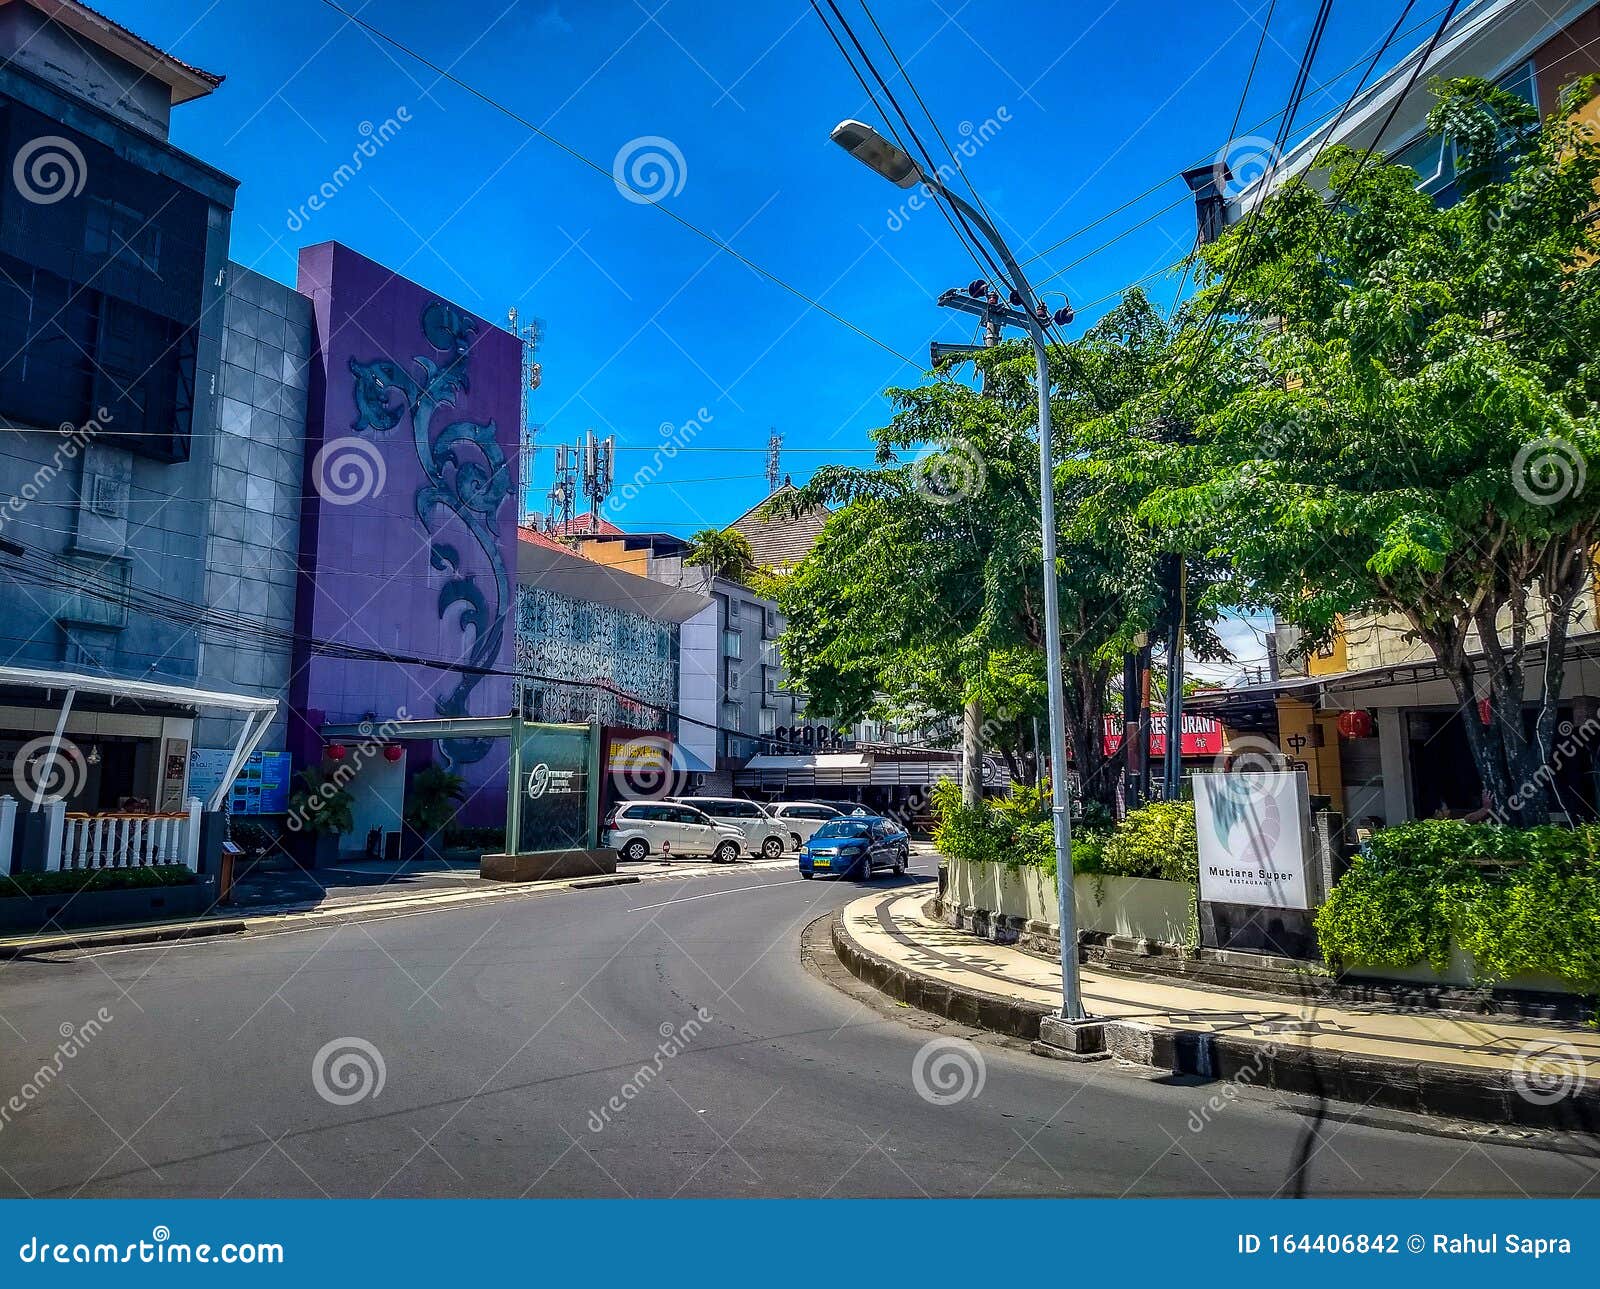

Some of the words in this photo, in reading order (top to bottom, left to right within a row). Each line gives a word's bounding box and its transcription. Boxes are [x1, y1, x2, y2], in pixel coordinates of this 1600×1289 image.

[1208, 866, 1253, 878] Mutiara
[1258, 869, 1293, 881] Super
[1229, 878, 1273, 886] RESTAURANT
